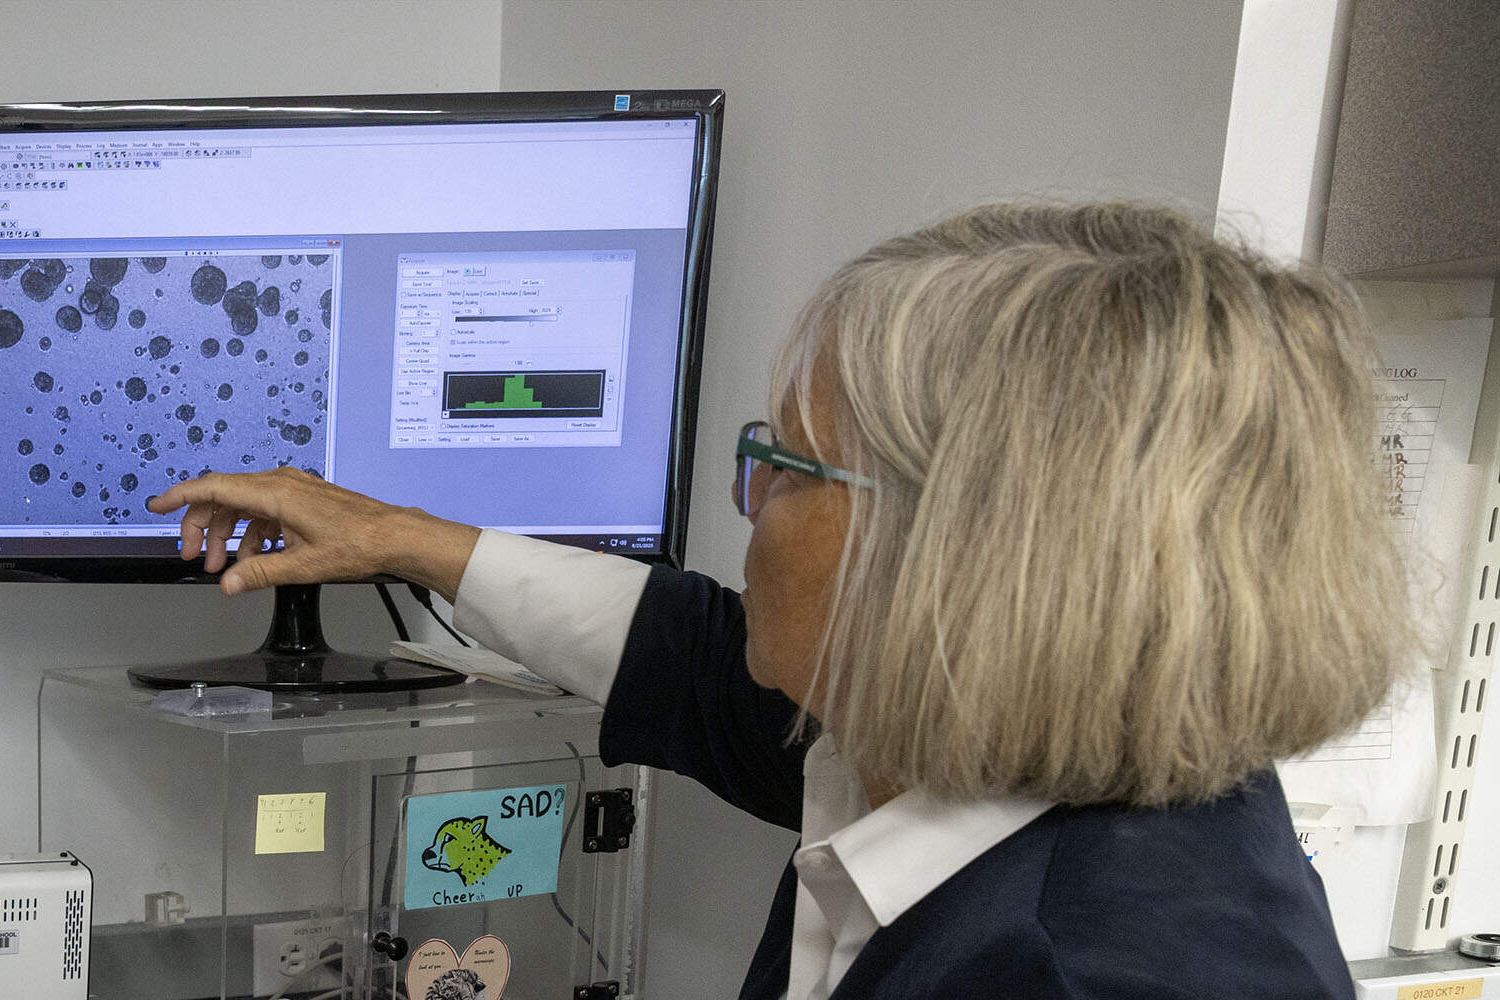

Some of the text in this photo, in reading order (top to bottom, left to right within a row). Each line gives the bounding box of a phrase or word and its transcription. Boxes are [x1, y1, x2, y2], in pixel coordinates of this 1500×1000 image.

[1394, 367, 1417, 378] LOG
[500, 788, 565, 819] SAD?
[507, 884, 523, 898] UP
[1413, 986, 1465, 1000] 0120 CKT 21
